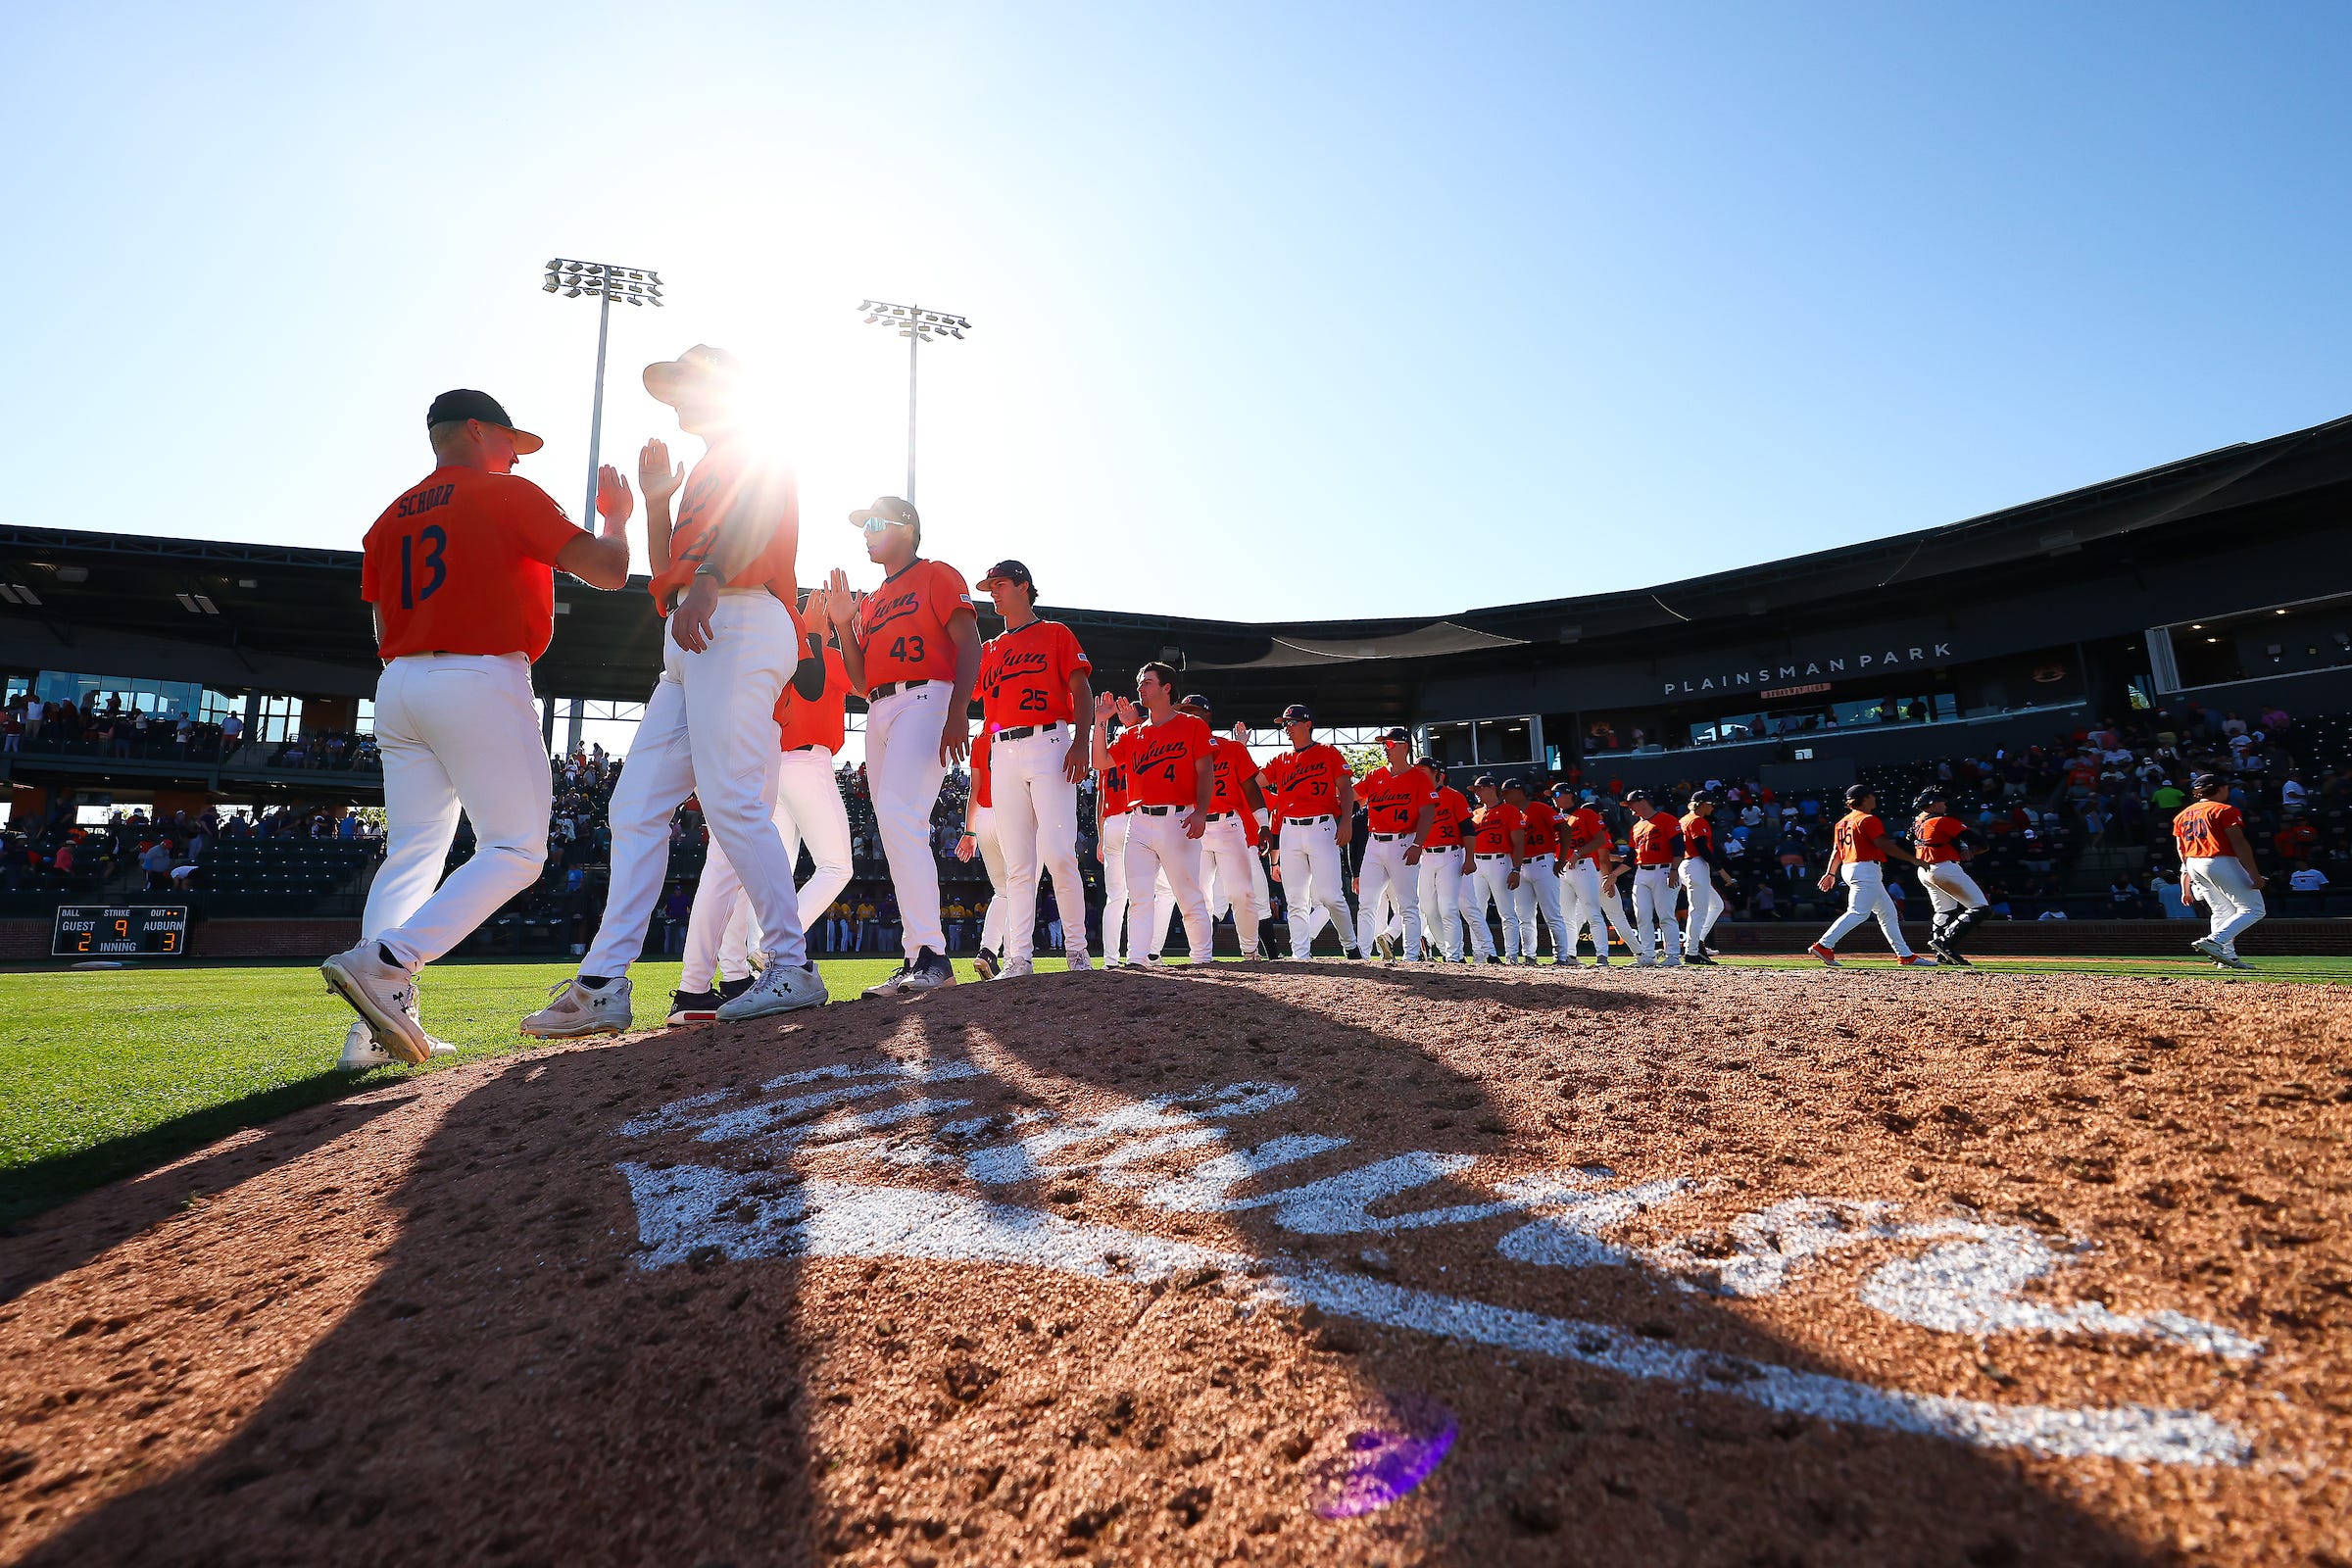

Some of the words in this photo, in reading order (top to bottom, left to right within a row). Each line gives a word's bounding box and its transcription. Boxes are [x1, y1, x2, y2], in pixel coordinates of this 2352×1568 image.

[397, 484, 455, 518] SCHORR
[401, 524, 447, 610] 13
[889, 636, 925, 662] 43
[1665, 658, 1845, 695] PLAINSMAN
[1859, 643, 1951, 668] PARK
[1019, 688, 1049, 711] 25
[1132, 740, 1188, 775] Auburn
[1163, 764, 1176, 782] 4
[1282, 762, 1327, 791] Auburn
[1310, 781, 1329, 797] 37
[1368, 788, 1412, 812] Auburn
[1394, 808, 1408, 823] 14
[1439, 825, 1455, 838] 32
[1838, 826, 1852, 849] 46
[2182, 817, 2208, 842] 20
[62, 921, 96, 932] GUEST
[114, 918, 128, 938] 9
[142, 921, 184, 932] AUBURN
[77, 932, 92, 952] 2
[100, 941, 137, 953] INNING
[162, 932, 176, 952] 3
